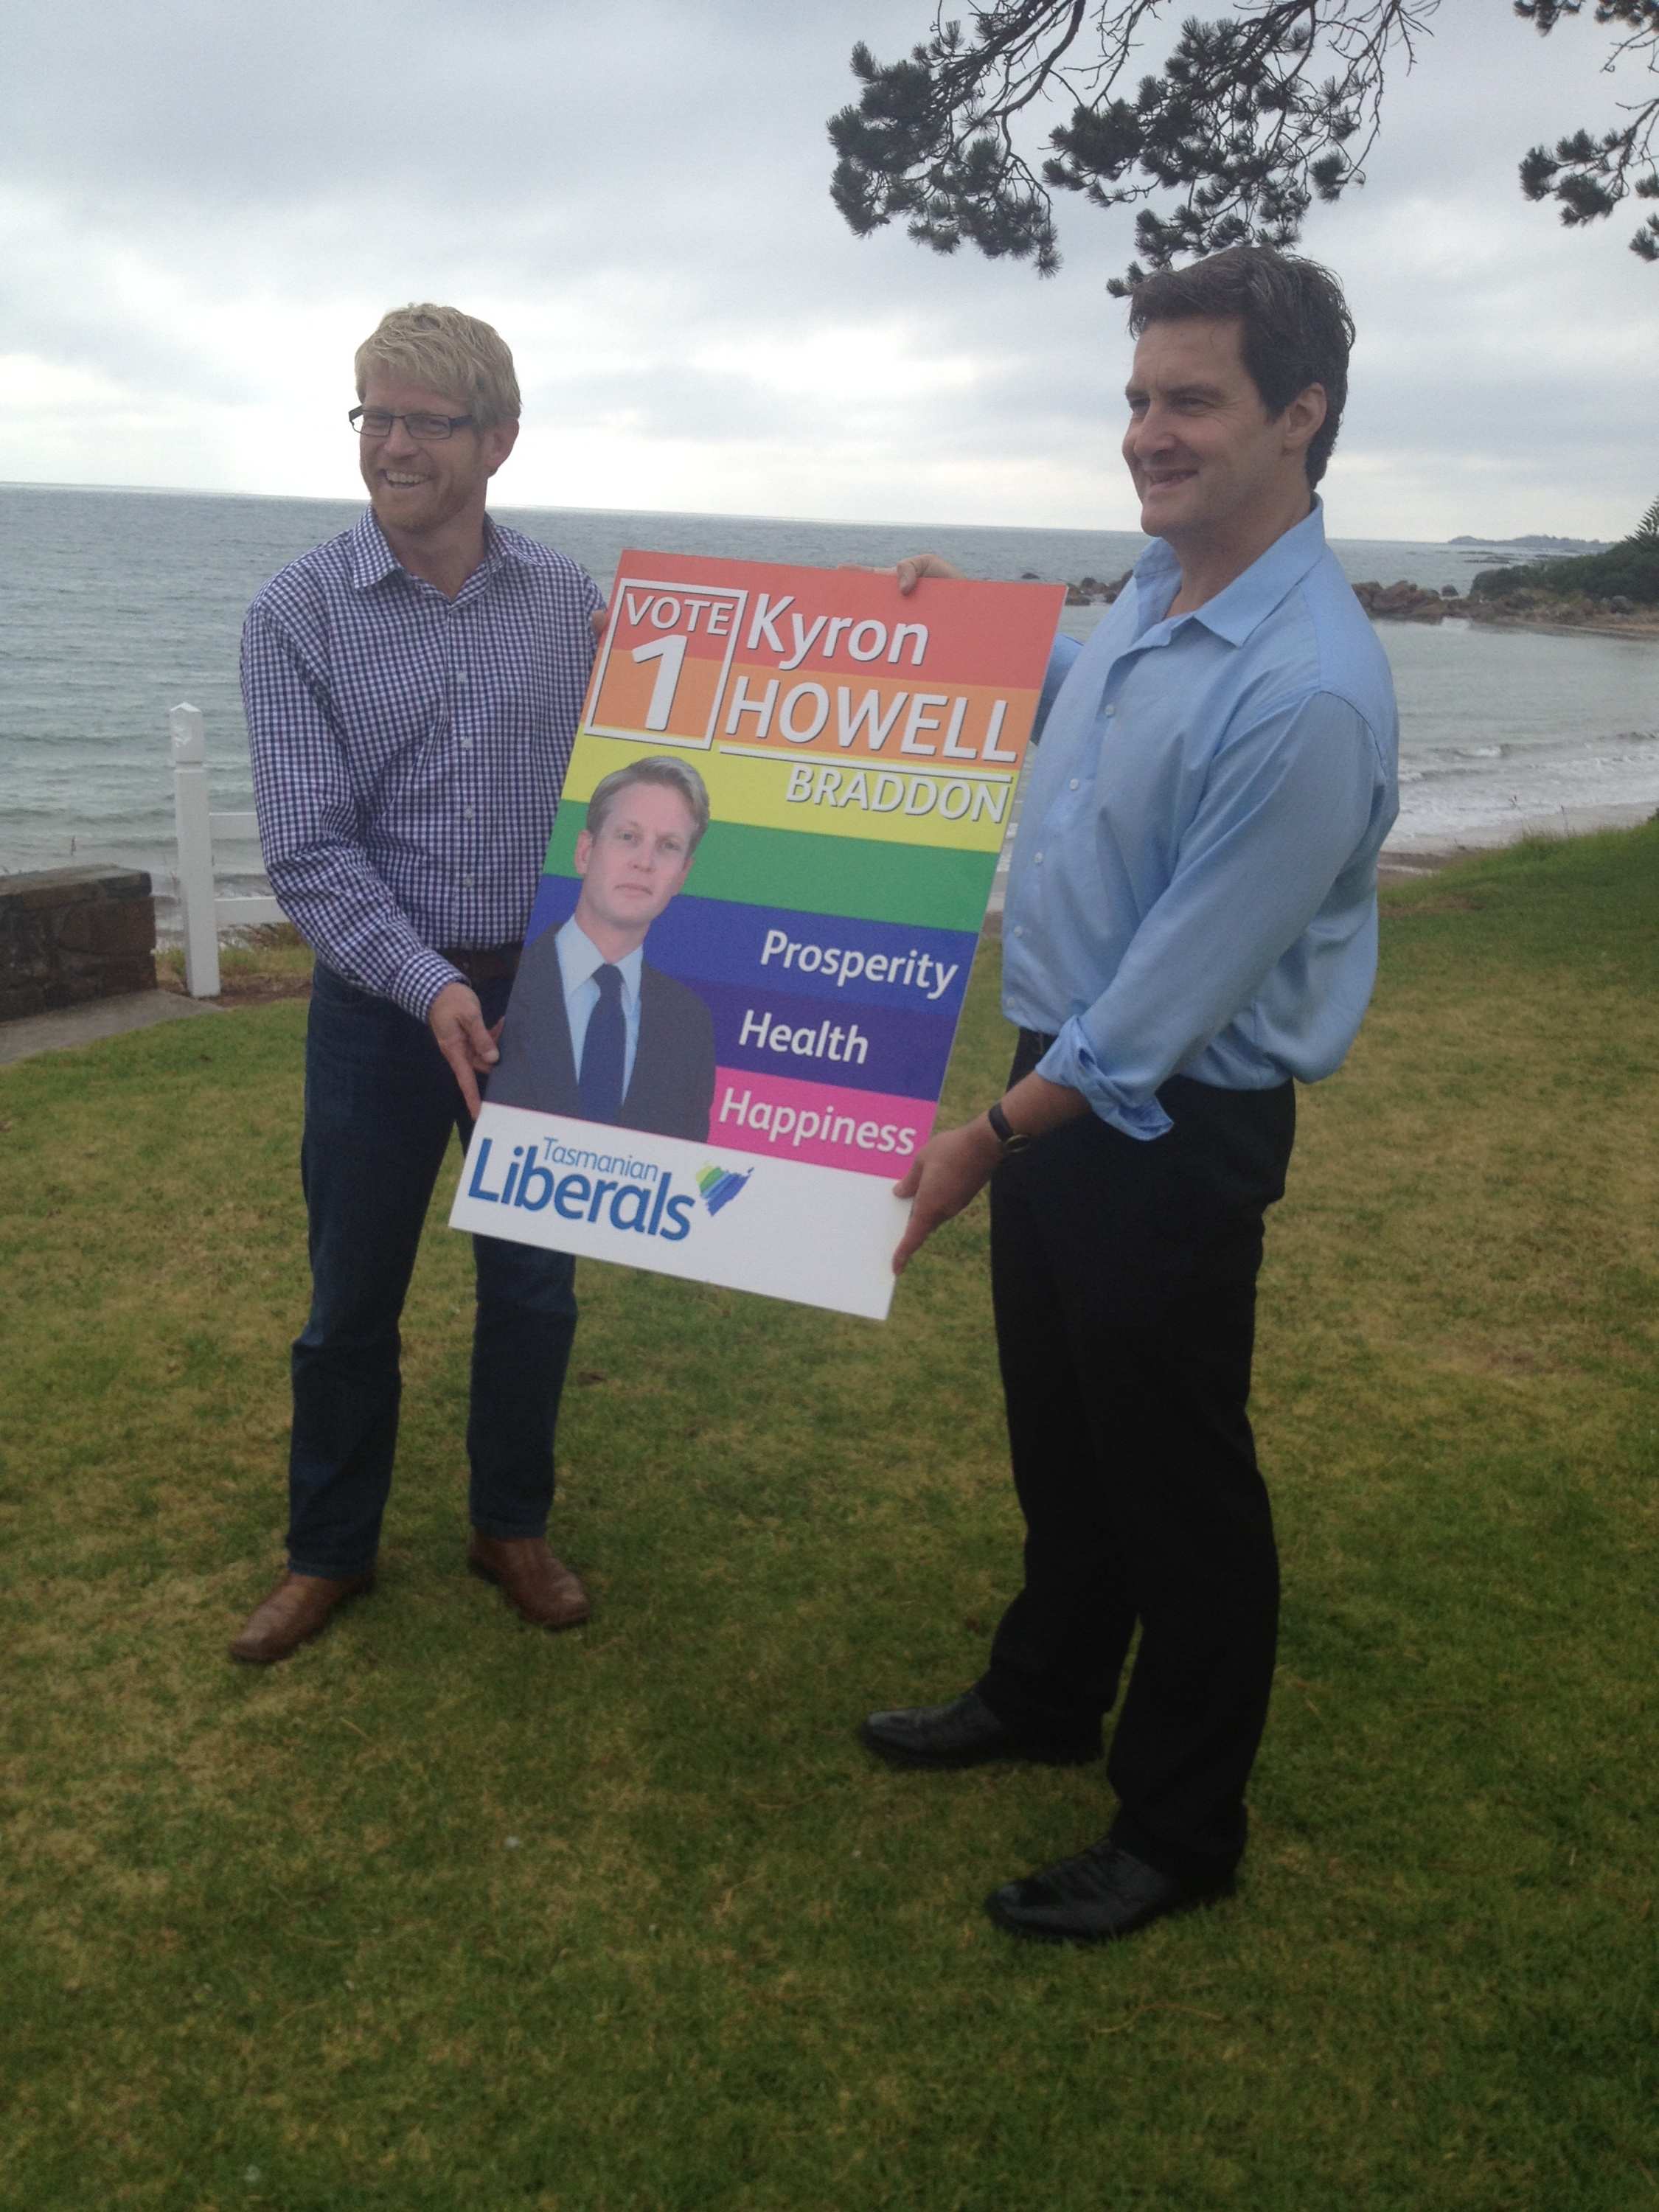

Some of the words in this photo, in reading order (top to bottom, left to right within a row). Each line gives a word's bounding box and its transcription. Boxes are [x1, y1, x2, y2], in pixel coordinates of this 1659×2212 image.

[625, 593, 734, 636] VOTE
[747, 592, 929, 671] Kyron
[632, 634, 688, 731] 1
[726, 676, 1018, 762] HOWELL
[786, 765, 1009, 824] BRADDON
[760, 930, 959, 1000] Prosperity
[739, 1009, 869, 1064] Health
[719, 1087, 917, 1156] Happiness
[467, 1138, 695, 1242] Liberals
[543, 1136, 658, 1182] Tasmanian
